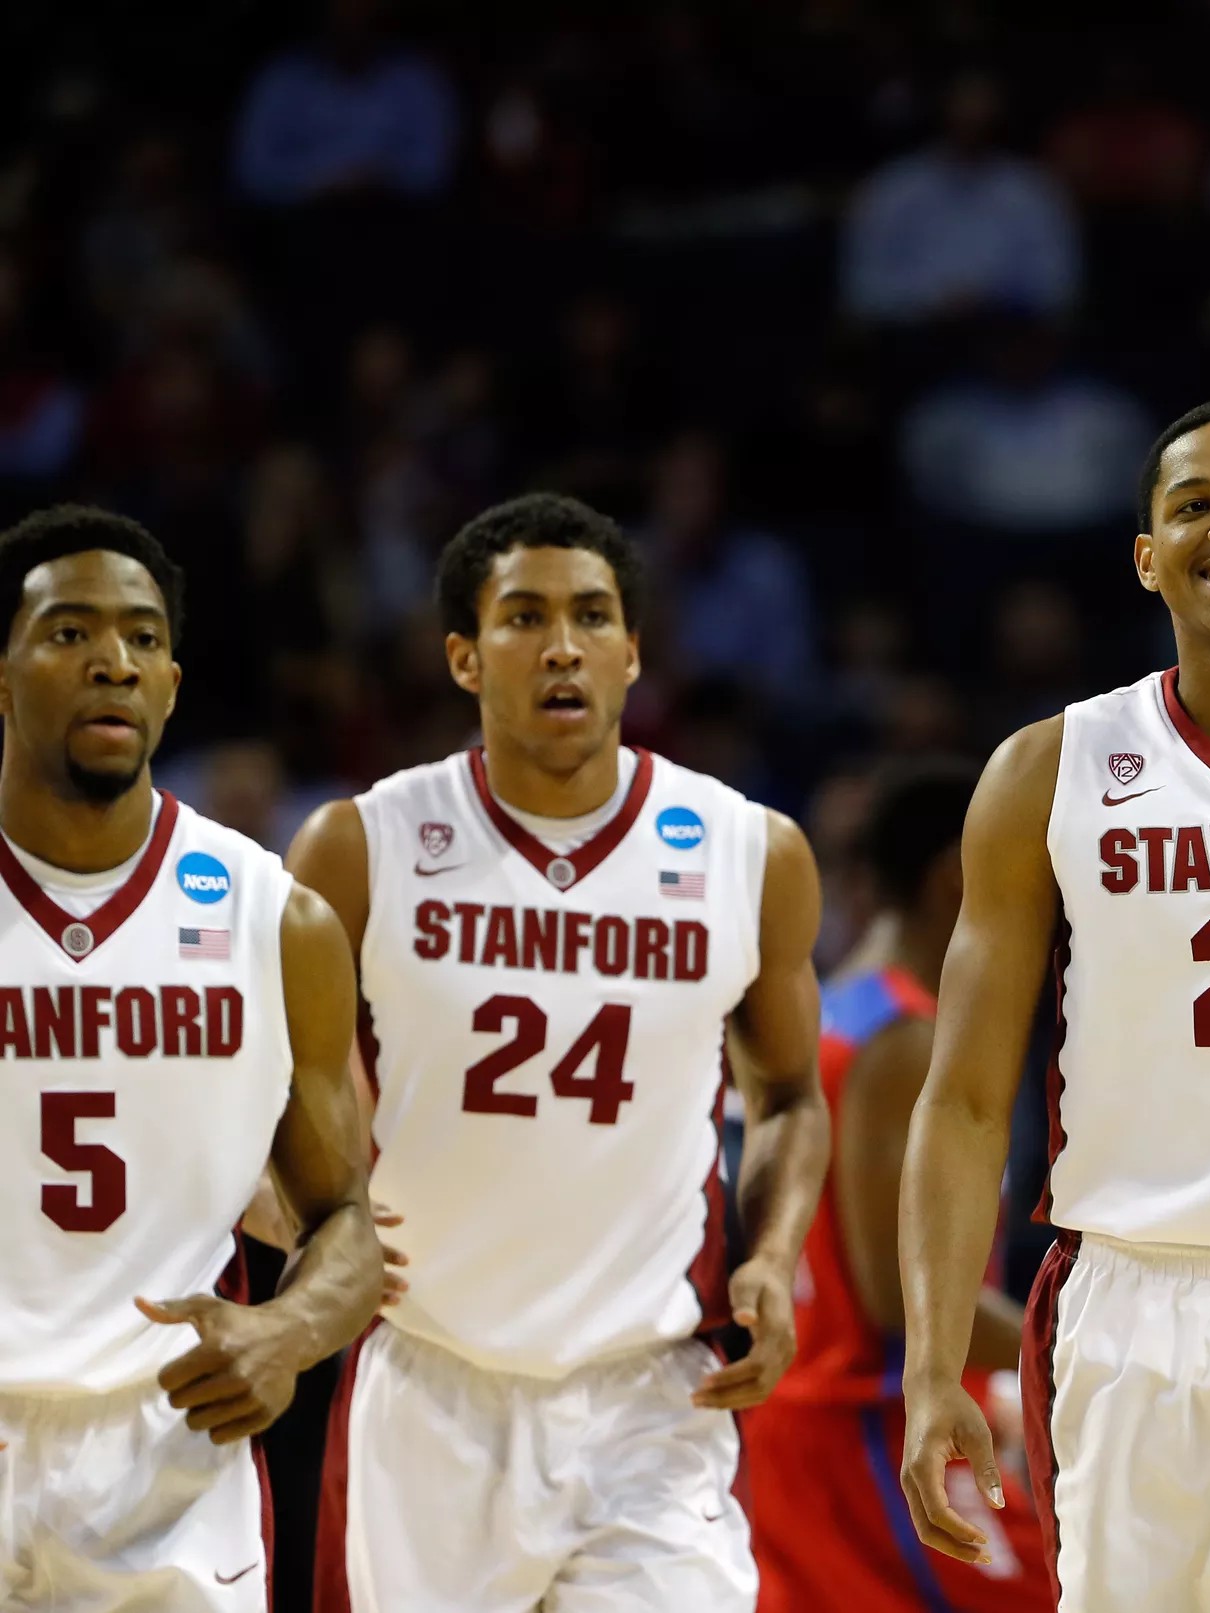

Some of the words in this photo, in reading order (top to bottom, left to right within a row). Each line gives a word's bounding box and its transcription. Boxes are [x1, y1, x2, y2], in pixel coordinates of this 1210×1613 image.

[1117, 766, 1133, 777] 12
[183, 873, 229, 891] NCAA
[413, 898, 709, 983] STANFORD
[0, 985, 244, 1060] ANFORD
[461, 994, 635, 1124] 24
[40, 1092, 127, 1233] 5
